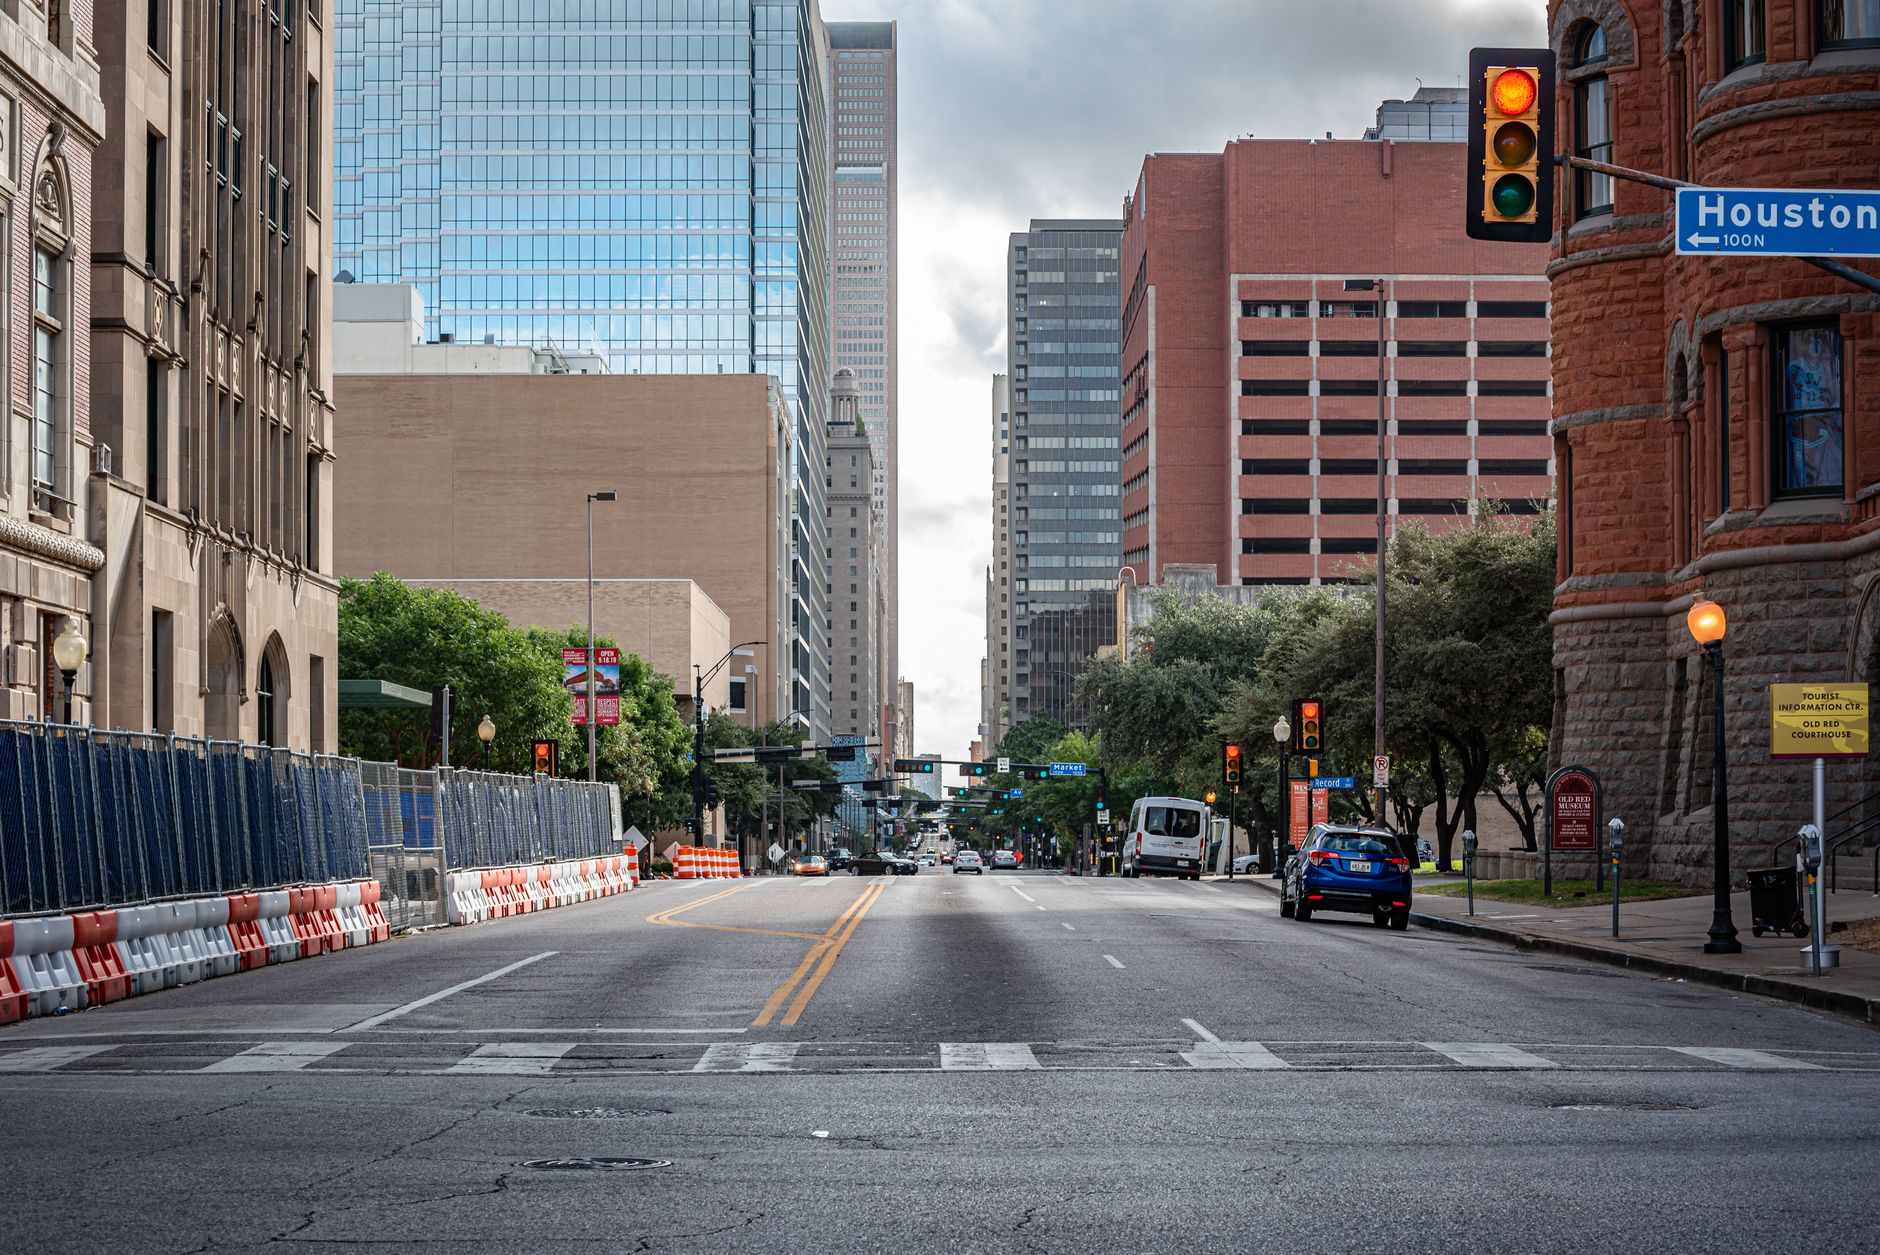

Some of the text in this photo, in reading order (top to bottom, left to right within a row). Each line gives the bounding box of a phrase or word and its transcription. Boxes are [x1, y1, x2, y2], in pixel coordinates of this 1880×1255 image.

[1699, 195, 1878, 229] Houston
[1723, 234, 1765, 247] 100N
[1779, 703, 1864, 711] INFORMATION CTR.
[1823, 720, 1840, 728] RED
[1314, 778, 1340, 787] Record
